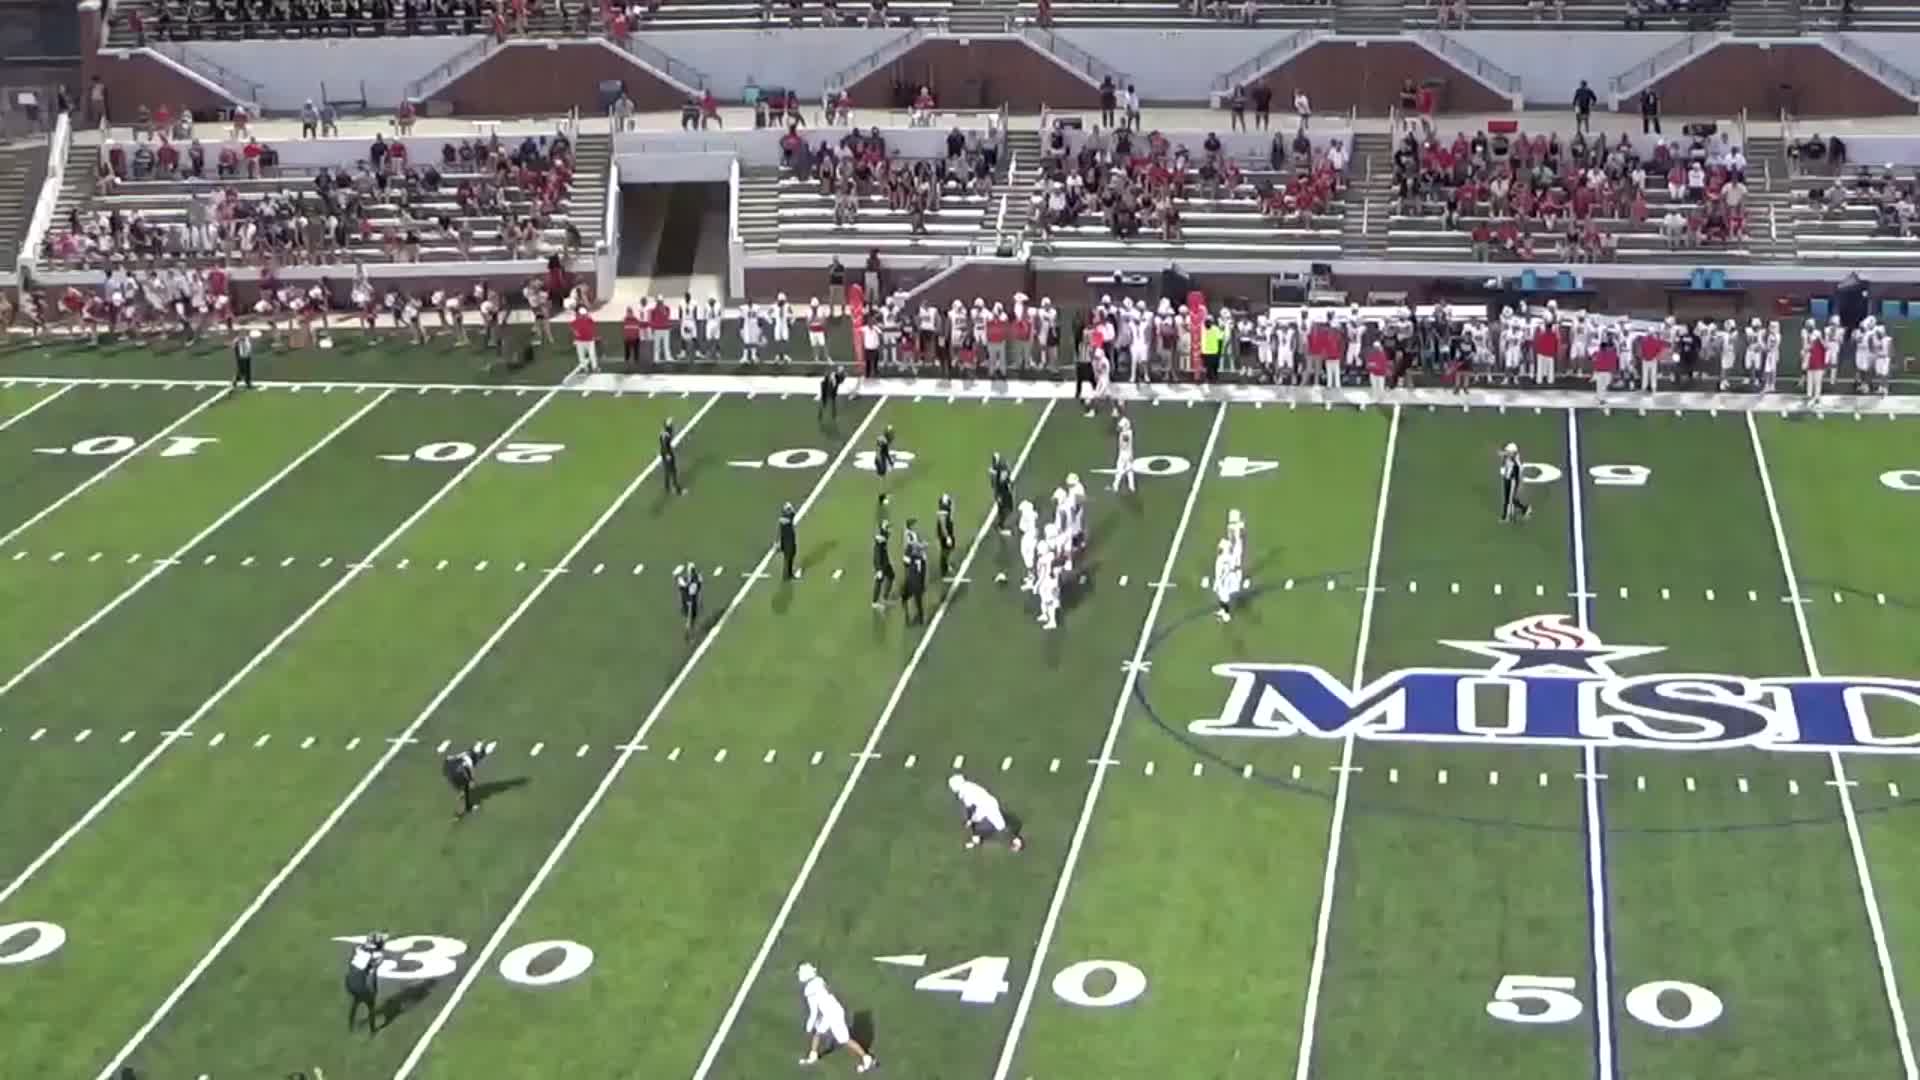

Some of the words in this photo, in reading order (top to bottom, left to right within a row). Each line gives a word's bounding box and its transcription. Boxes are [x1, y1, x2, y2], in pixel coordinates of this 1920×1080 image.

[71, 435, 217, 457] 10
[414, 441, 565, 464] 20
[1131, 455, 1280, 478] 40
[1188, 663, 1920, 754] MISD
[376, 935, 594, 986] 30
[914, 955, 1148, 1008] 40
[1486, 974, 1724, 1030] 50
